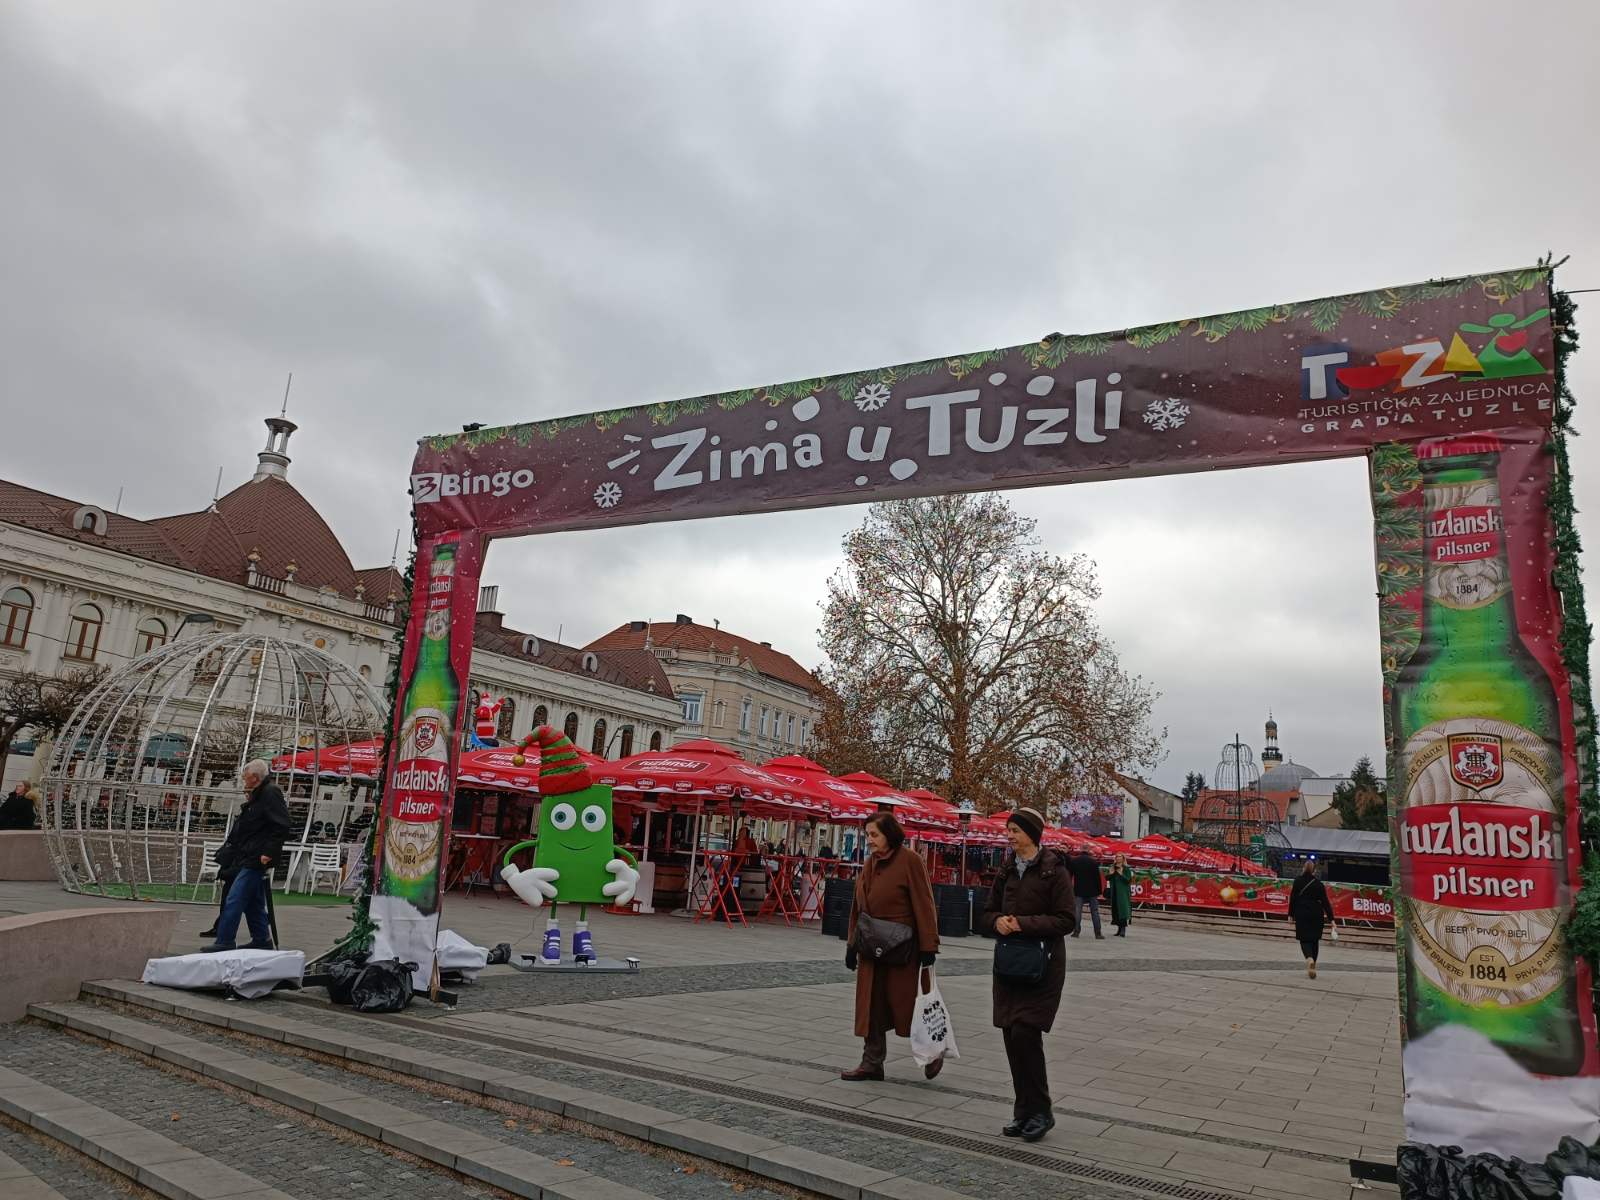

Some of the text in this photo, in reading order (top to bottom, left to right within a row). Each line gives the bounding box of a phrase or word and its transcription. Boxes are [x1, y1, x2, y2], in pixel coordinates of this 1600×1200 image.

[1300, 382, 1550, 420] TURISTIČKA ZAJEDNICA
[1301, 398, 1551, 433] GRADA TUZLE
[651, 371, 1123, 492] Zima u Tuzli
[440, 468, 534, 497] Bingo
[1436, 541, 1491, 560] pilsner
[392, 760, 450, 792] tuzlanski
[398, 796, 434, 817] pilsner
[1401, 807, 1563, 859] tuzlanski
[1433, 867, 1534, 900] pilsner
[1363, 898, 1392, 915] Bingo
[1469, 964, 1508, 982] 1884
